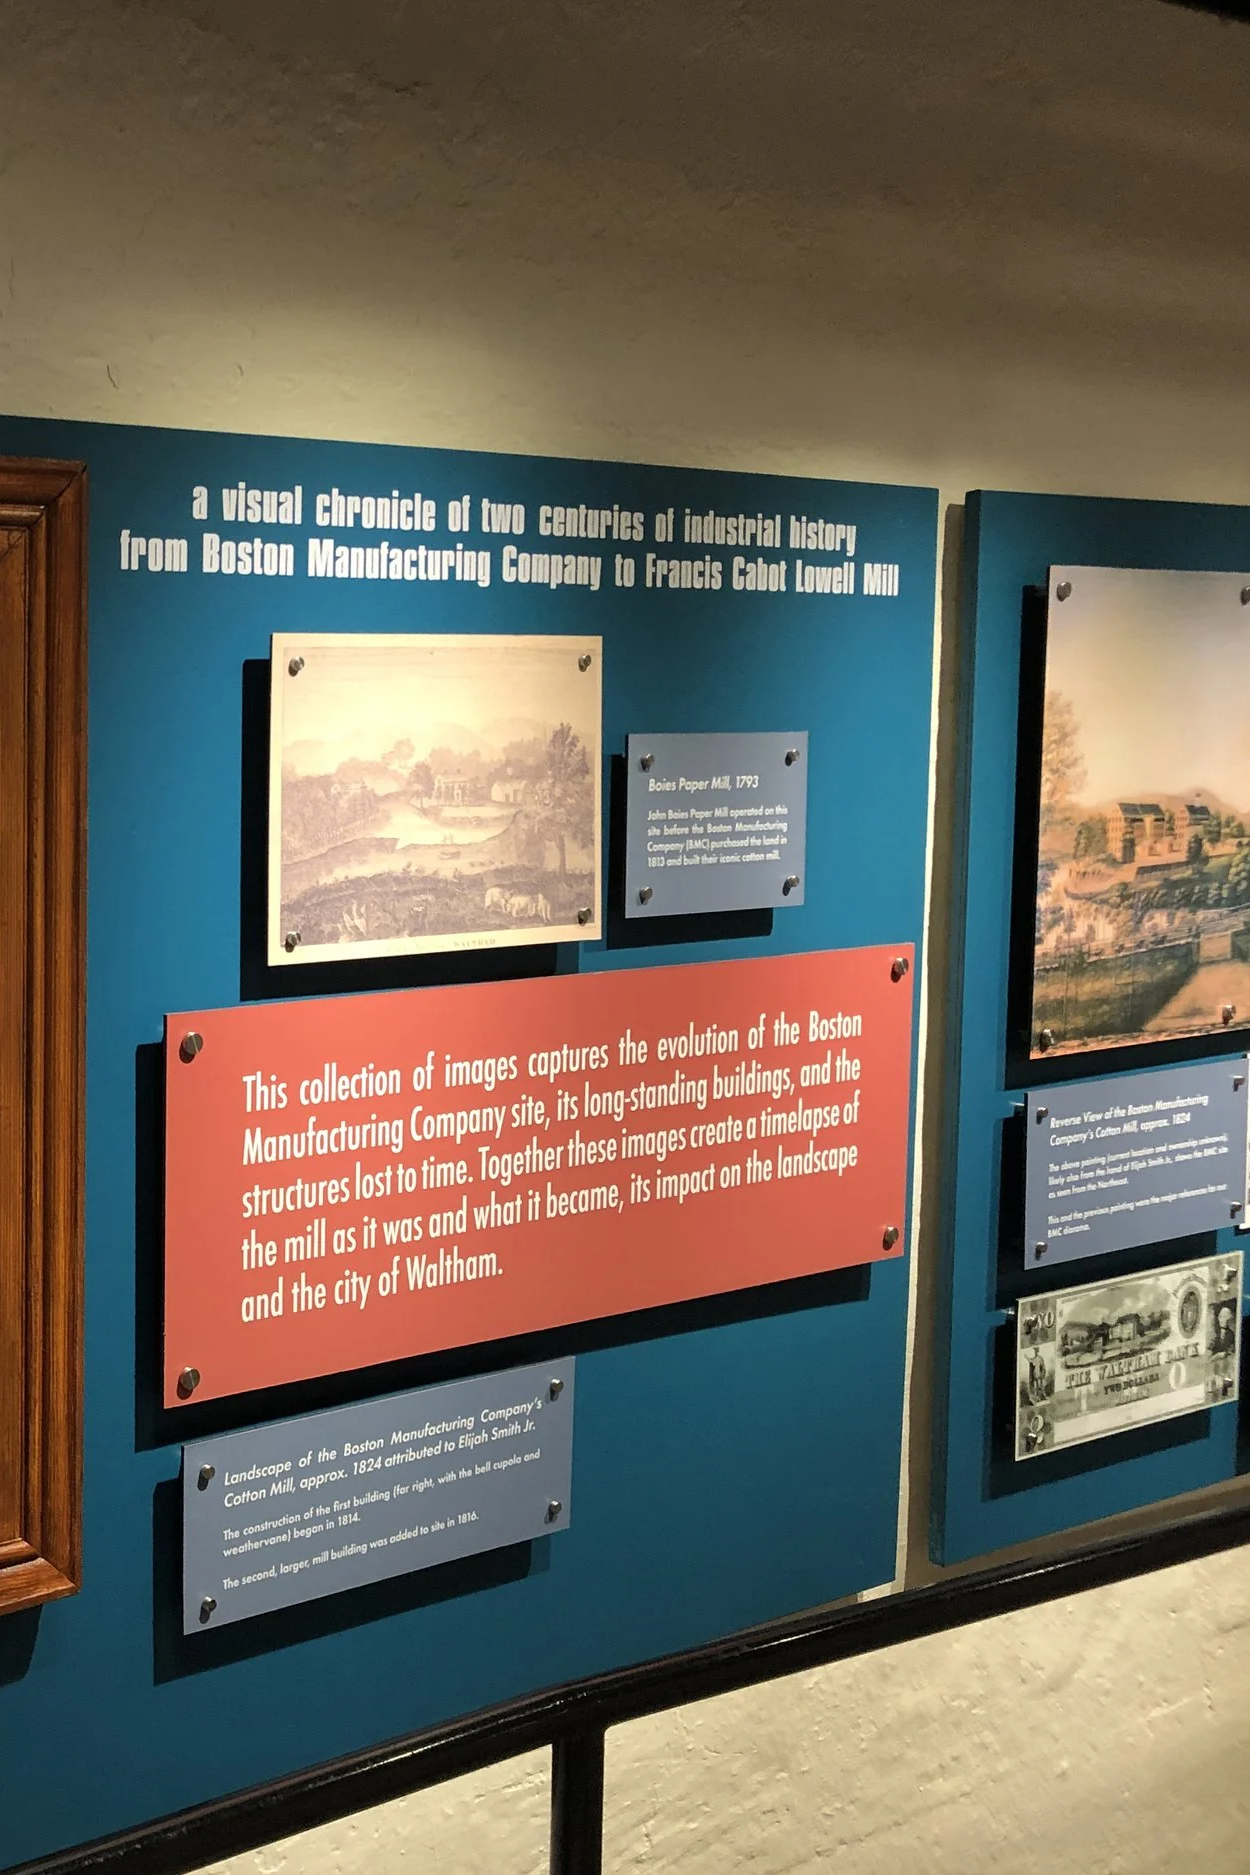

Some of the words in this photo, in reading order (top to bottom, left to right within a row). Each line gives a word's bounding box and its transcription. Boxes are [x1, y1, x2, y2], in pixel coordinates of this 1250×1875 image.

[193, 486, 207, 519] a
[222, 482, 302, 524] visual
[316, 488, 436, 531] chronicle
[448, 495, 470, 532] of
[482, 498, 525, 534] two
[539, 505, 644, 541] centuries
[655, 508, 674, 542] of
[685, 509, 781, 547] industrial
[790, 515, 856, 556] history
[120, 530, 187, 572] from
[203, 533, 294, 576] Boston
[308, 538, 490, 587] Manufacturing
[502, 545, 601, 590] Company
[615, 554, 634, 587] to
[646, 553, 722, 589] Francis
[733, 556, 787, 591] Cabot
[796, 554, 855, 594] Lowell
[863, 563, 899, 596] Mill
[647, 810, 666, 820] John
[668, 809, 689, 819] Boies
[690, 808, 713, 821] Paper
[714, 807, 728, 817] Mill
[730, 805, 763, 819] operated
[775, 805, 788, 814] this
[649, 778, 676, 791] Boies
[679, 777, 709, 793] Paper
[711, 776, 732, 791] Mill,
[736, 775, 758, 788] 1793
[647, 826, 661, 836] site
[664, 824, 689, 835] before
[692, 823, 704, 834] the
[707, 823, 732, 833] Boston
[735, 820, 787, 832] Manufacturing
[243, 1071, 287, 1112] This
[300, 1063, 400, 1105] collection
[413, 1051, 434, 1091] of
[445, 1055, 517, 1091] images
[529, 1044, 608, 1083] captures
[619, 1030, 647, 1065] the
[658, 1022, 739, 1062] evolution
[748, 1013, 766, 1050] of
[774, 1012, 801, 1047] the
[809, 1011, 863, 1042] Boston
[243, 1114, 403, 1165] Manufacturing
[411, 1106, 506, 1144] Company
[512, 1094, 550, 1130] site,
[558, 1090, 578, 1121] its
[585, 1070, 707, 1121] long-standing
[713, 1061, 794, 1099] buildings,
[800, 1050, 832, 1088] and
[835, 1048, 861, 1081] the
[243, 1178, 350, 1218] structures
[356, 1161, 392, 1200] lost
[397, 1164, 416, 1193] to
[421, 1156, 473, 1189] time.
[478, 1136, 564, 1186] Together
[568, 1131, 617, 1167] these
[622, 1128, 686, 1161] images
[690, 1116, 742, 1148] create
[747, 1118, 758, 1140] a
[760, 1098, 841, 1137] timelapse
[843, 1090, 861, 1125] of
[242, 1229, 277, 1270] the
[285, 1218, 326, 1262] mill
[333, 1227, 356, 1254] as
[363, 1216, 377, 1249] it
[383, 1216, 422, 1245] was
[429, 1196, 468, 1238] and
[473, 1191, 522, 1229] what
[528, 1190, 540, 1221] it
[547, 1182, 623, 1218] became,
[631, 1173, 650, 1203] its
[657, 1163, 715, 1203] impact
[720, 1165, 740, 1188] on
[746, 1149, 772, 1184] the
[778, 1141, 857, 1178] landscape
[242, 1276, 283, 1322] and
[292, 1272, 326, 1312] the
[335, 1270, 371, 1309] city
[379, 1256, 400, 1296] of
[406, 1246, 502, 1290] Waltham.
[224, 1489, 266, 1507] Cotton
[270, 1477, 296, 1496] Mill,
[300, 1469, 347, 1490] approx.
[354, 1456, 381, 1475] 1824
[385, 1442, 442, 1467] attributed
[444, 1441, 455, 1452] to
[459, 1430, 489, 1449] Elijah
[491, 1421, 522, 1441] Smith
[523, 1419, 536, 1432] Jr.
[225, 1462, 291, 1486] Landscape
[299, 1451, 312, 1467] of
[318, 1448, 336, 1463] the
[344, 1439, 384, 1456] Boston
[391, 1416, 474, 1445] Manufacturing
[481, 1397, 542, 1422] Company's
[223, 1529, 239, 1540] The
[243, 1514, 300, 1535] construction
[304, 1507, 313, 1519] of
[316, 1505, 330, 1516] the
[334, 1500, 350, 1512] first
[354, 1491, 391, 1507] building
[393, 1485, 409, 1498] (far
[412, 1478, 434, 1492] right,
[438, 1471, 456, 1484] with
[459, 1468, 472, 1479] the
[475, 1462, 490, 1474] bell
[493, 1455, 521, 1470] cupola
[524, 1448, 540, 1461] and
[223, 1529, 291, 1556] weathervane)
[294, 1524, 323, 1538] began
[326, 1520, 334, 1529] in
[338, 1514, 360, 1526] 1814.
[223, 1578, 239, 1589] The
[242, 1565, 277, 1584] second,
[280, 1560, 309, 1574] larger,
[313, 1551, 329, 1565] mill
[331, 1544, 367, 1559] building
[370, 1538, 388, 1548] was
[390, 1526, 418, 1543] added
[420, 1527, 429, 1535] to
[431, 1522, 445, 1532] site
[447, 1519, 455, 1527] in
[458, 1511, 479, 1525] 1816.
